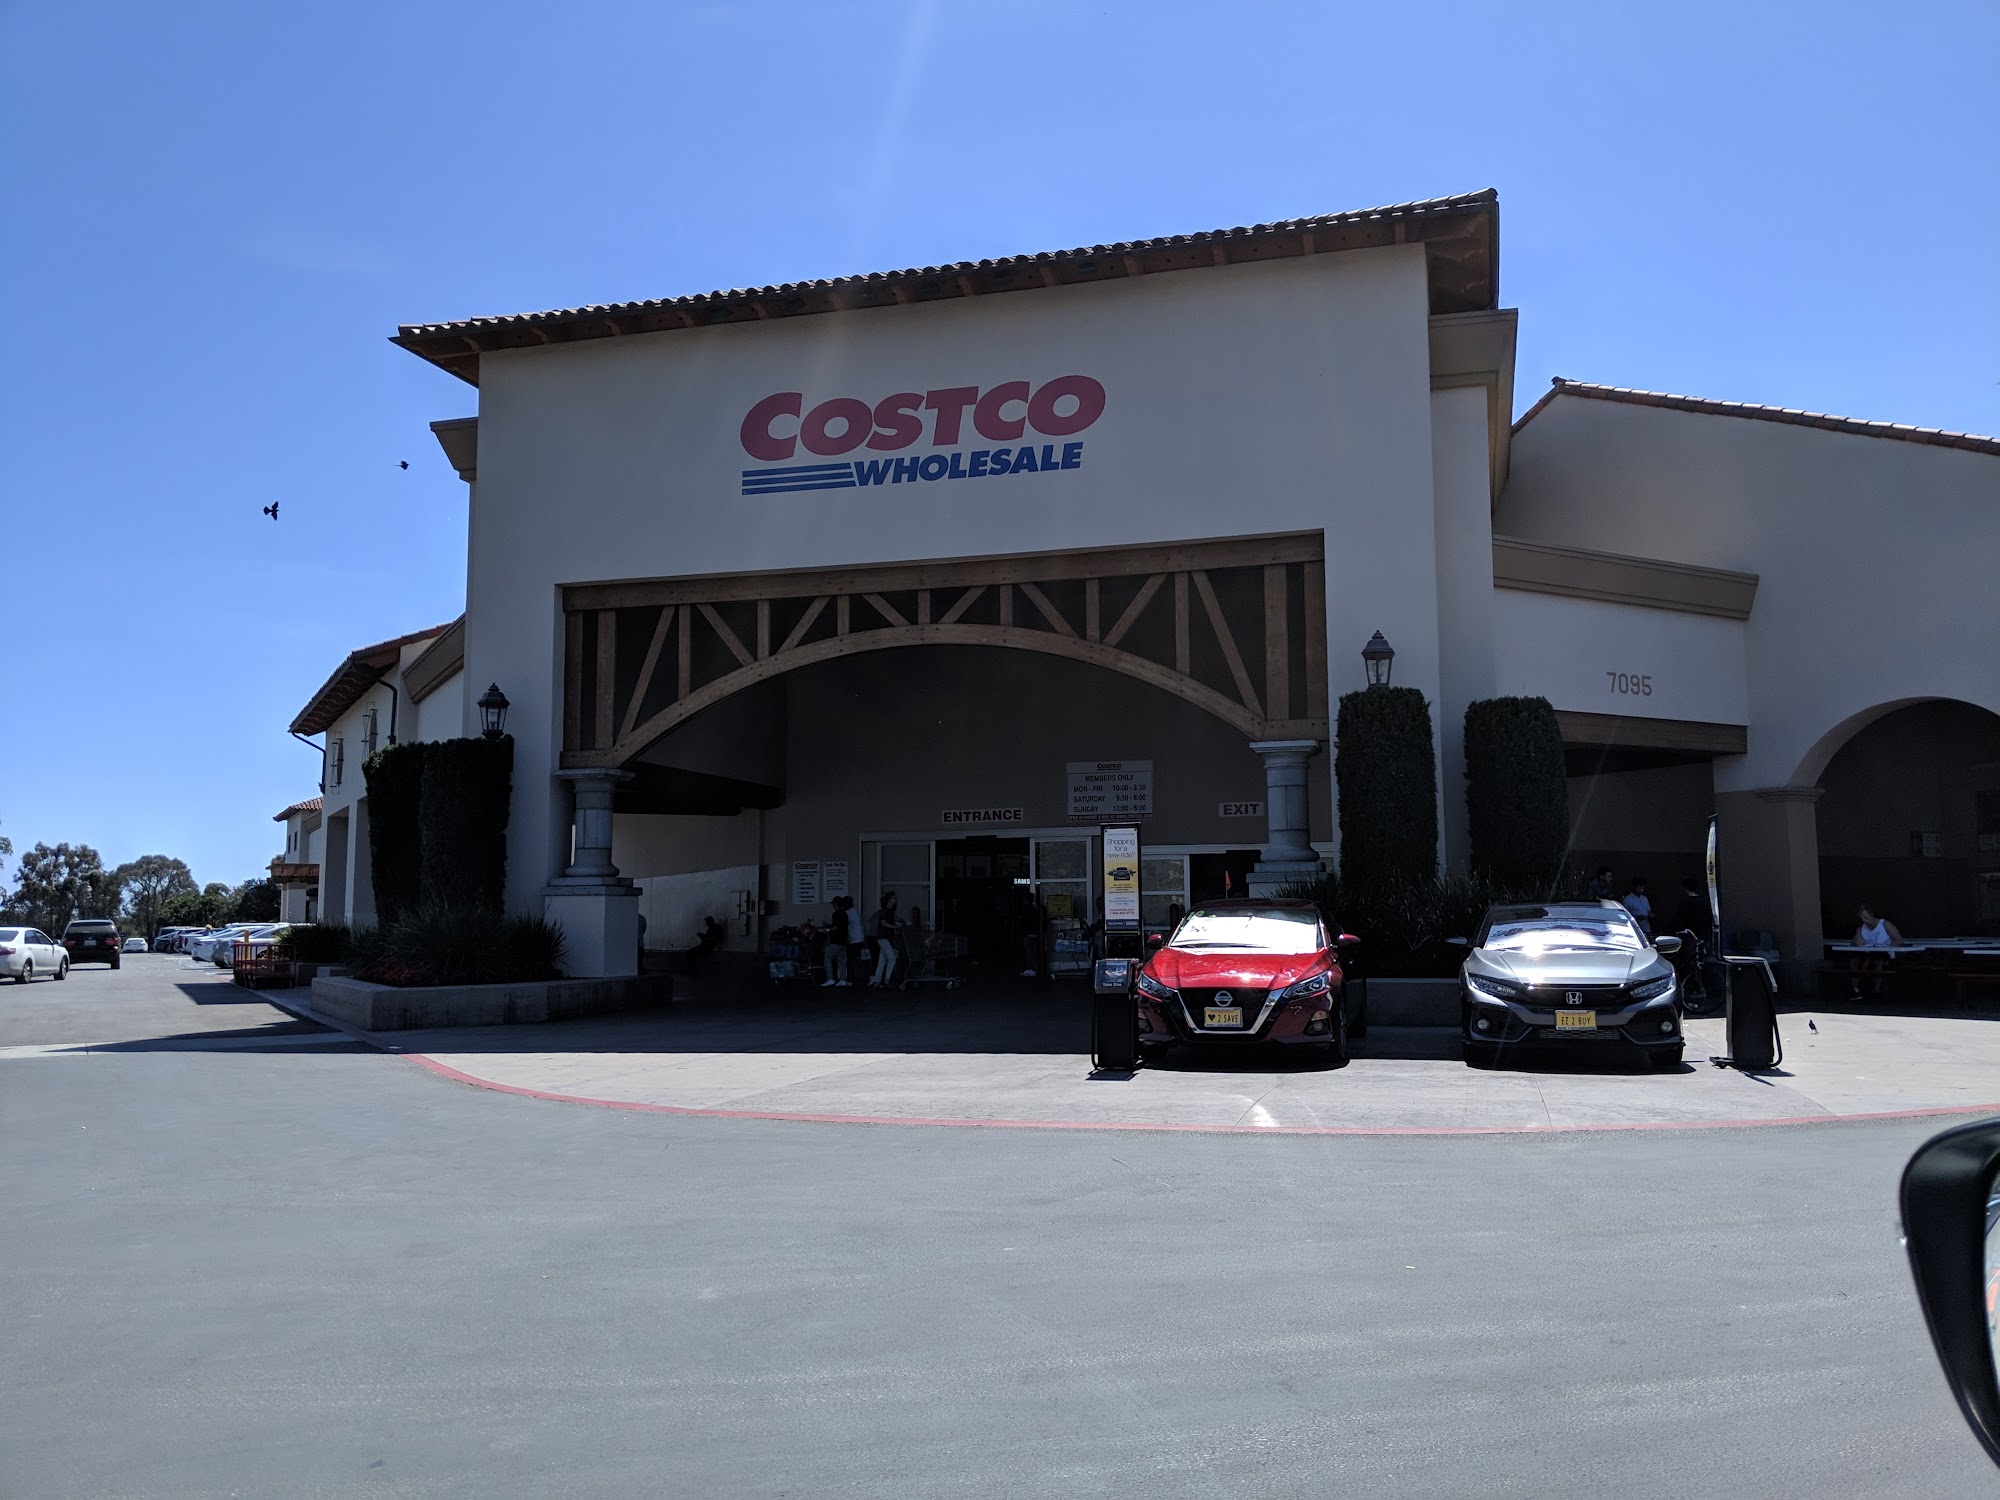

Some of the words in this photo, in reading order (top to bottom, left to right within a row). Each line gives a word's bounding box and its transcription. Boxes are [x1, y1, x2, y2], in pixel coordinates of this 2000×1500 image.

[740, 374, 1106, 461] COSTCO
[854, 442, 1084, 486] WHOLESALE
[1606, 671, 1652, 697] 7095
[1073, 795, 1106, 803] SATURDAY
[1223, 803, 1259, 815] EXIT
[943, 809, 1022, 823] ENTRANCE
[1106, 838, 1135, 846] Shopping
[1217, 1014, 1221, 1023] 2
[1223, 1014, 1239, 1023] SAVE
[1561, 1016, 1569, 1025] EZ
[1571, 1016, 1575, 1025] 2
[1578, 1016, 1591, 1025] BUY
